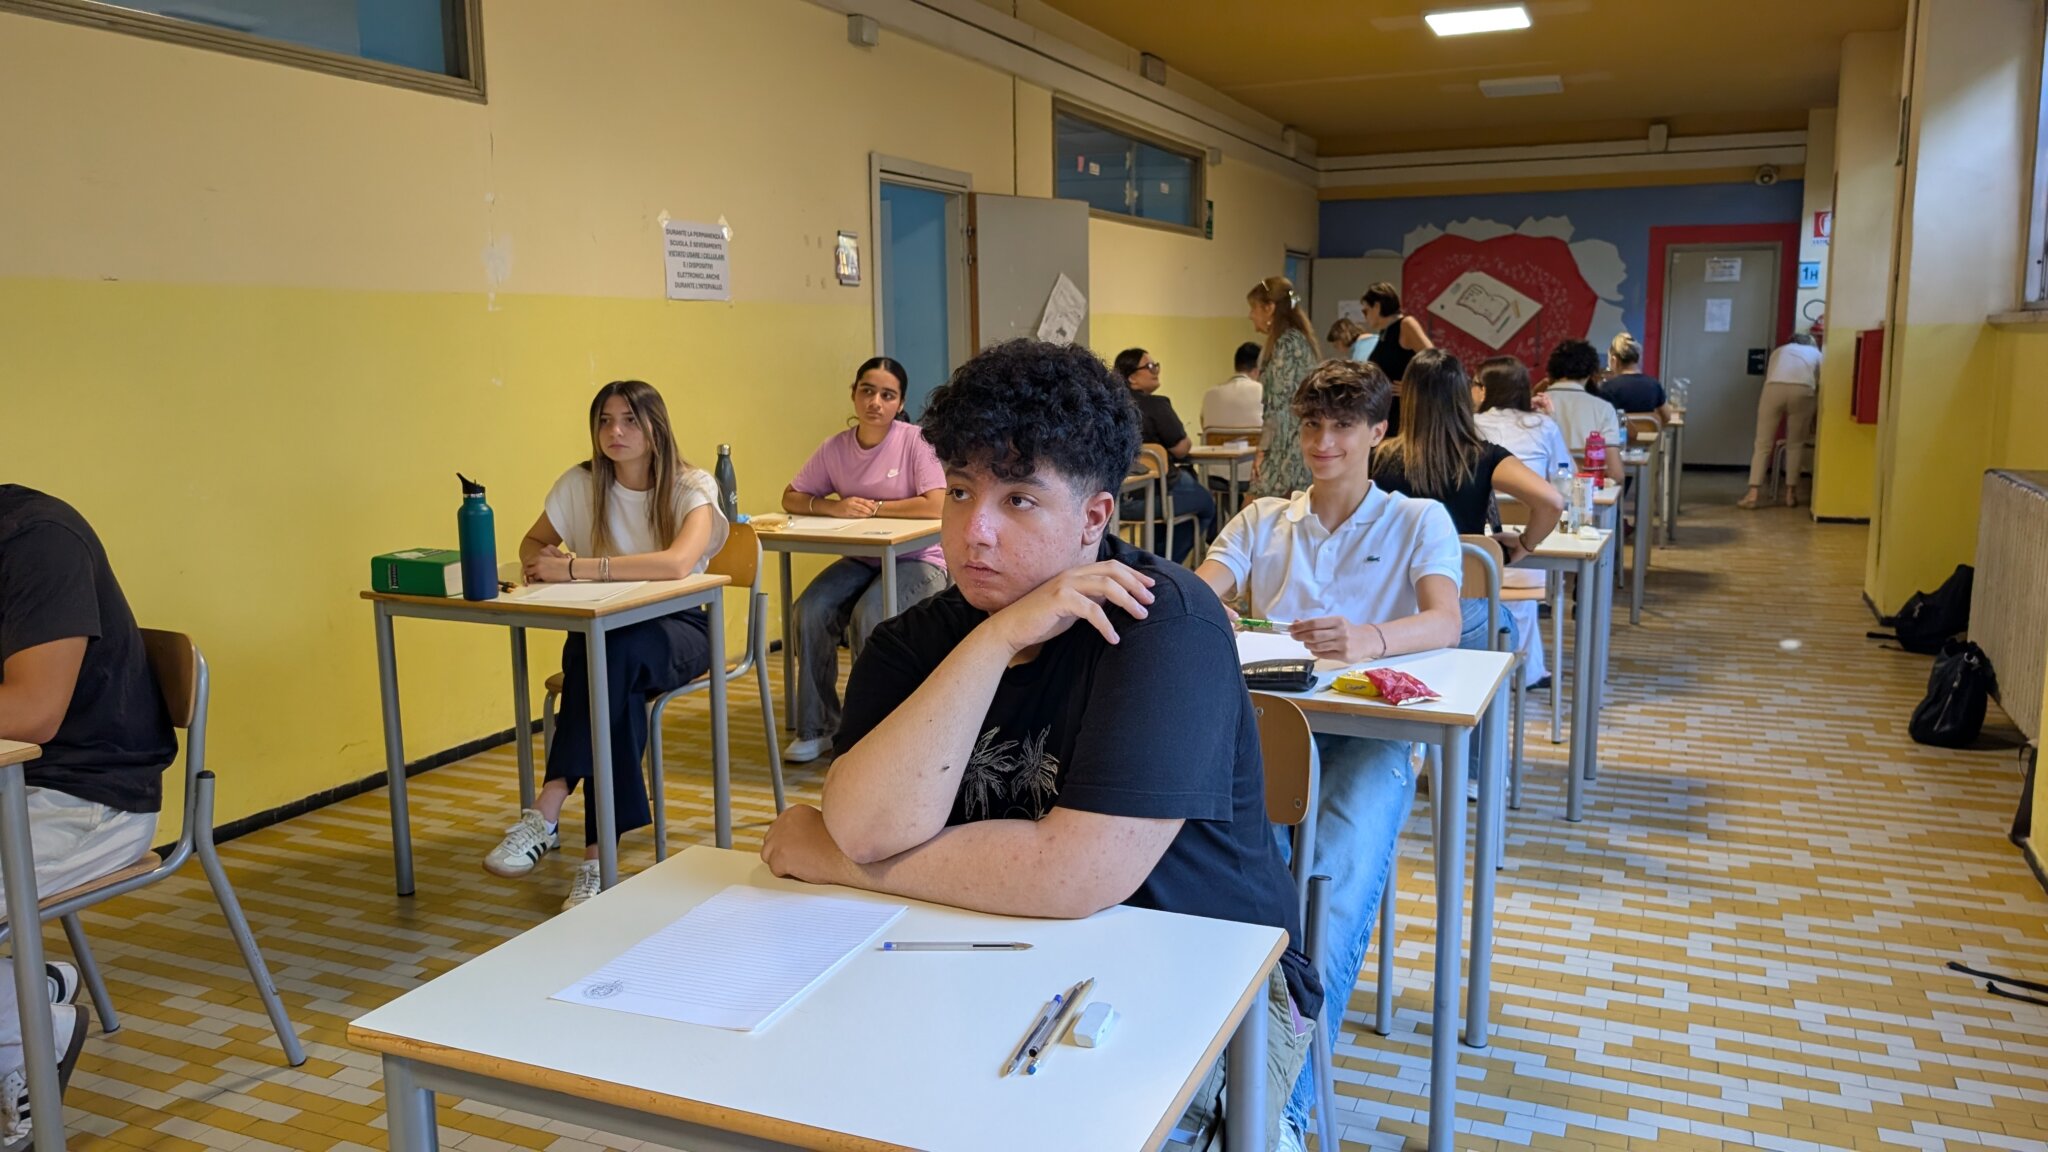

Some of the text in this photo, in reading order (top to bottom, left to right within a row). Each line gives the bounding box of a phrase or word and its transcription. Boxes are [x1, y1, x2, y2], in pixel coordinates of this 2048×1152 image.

[666, 228, 686, 236] DURANTE
[693, 231, 720, 240] PERMANENZA
[693, 241, 722, 250] SEVERAMENTE
[703, 252, 725, 261] CELLULARI
[689, 262, 713, 270] DISPOSITIVI
[705, 273, 720, 281] ANCHE
[1802, 266, 1818, 281] 1H
[675, 281, 695, 289] DURANTE
